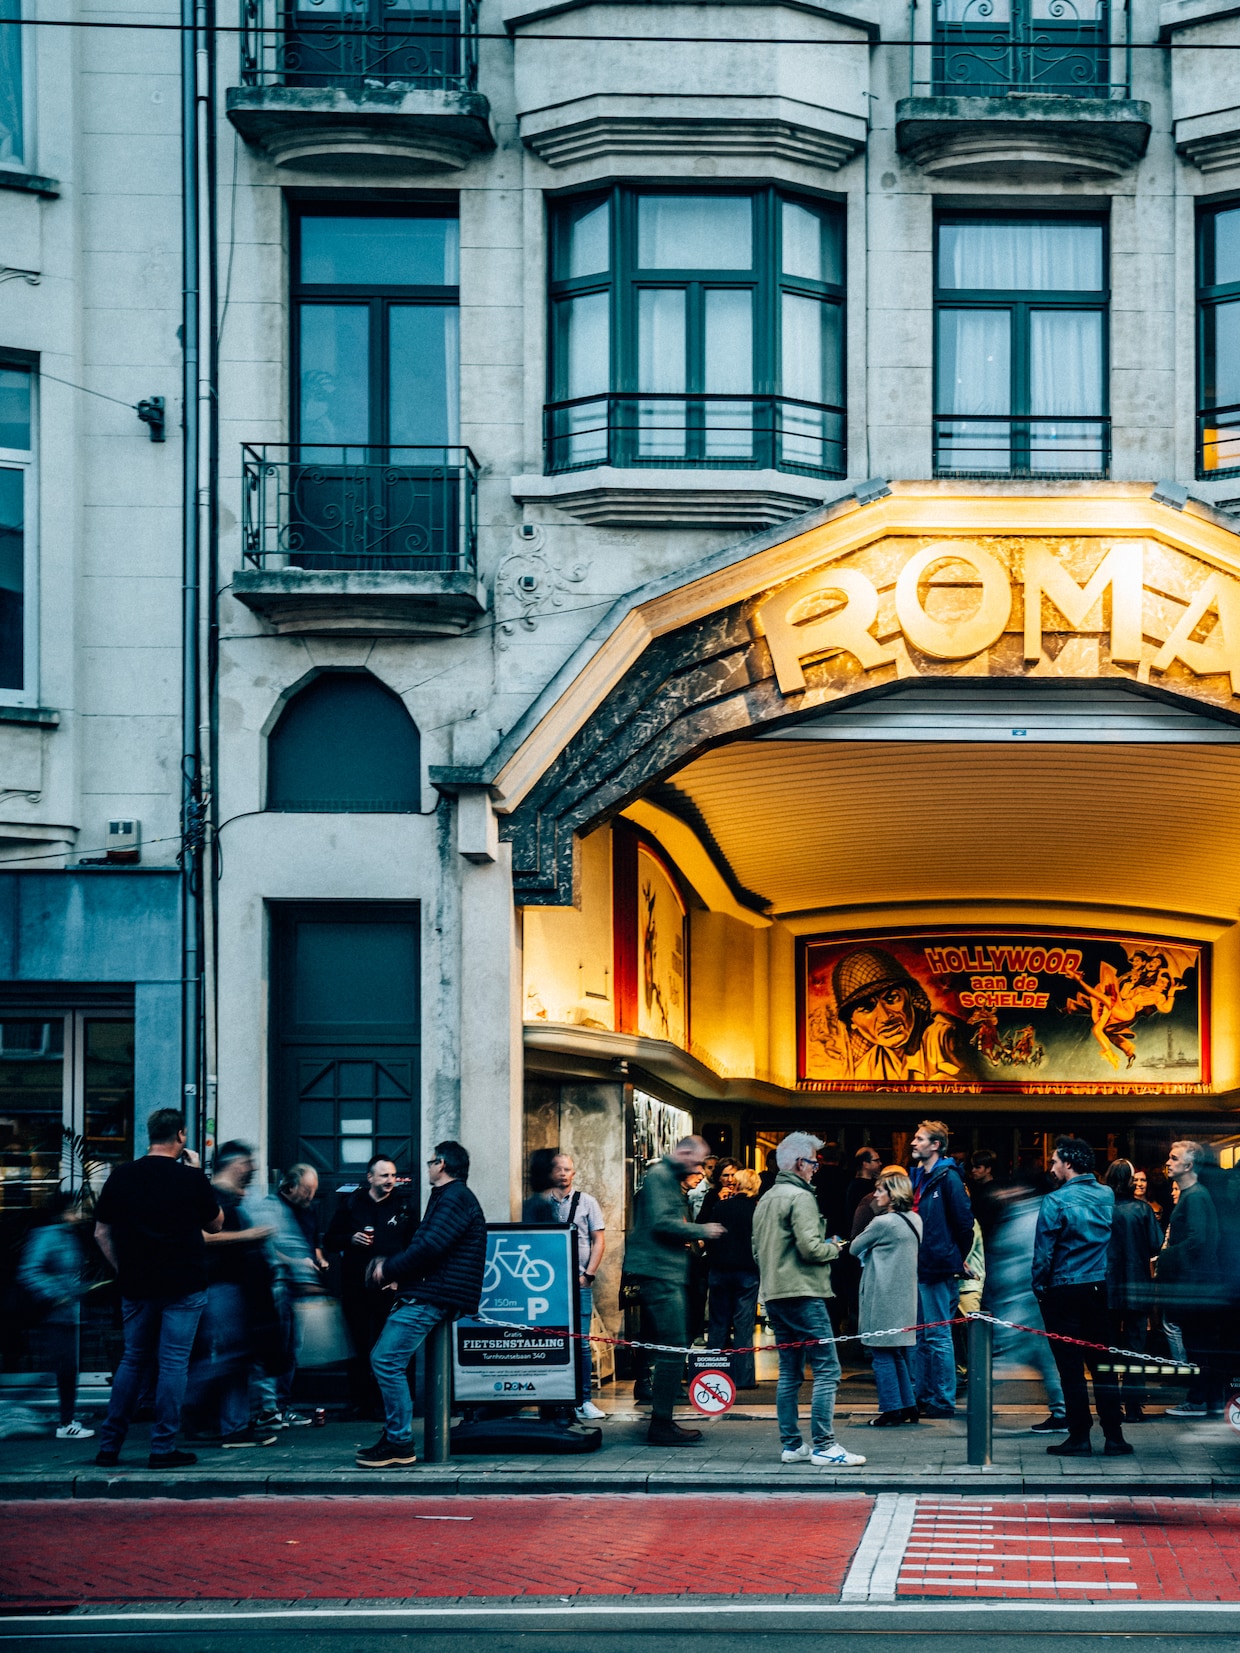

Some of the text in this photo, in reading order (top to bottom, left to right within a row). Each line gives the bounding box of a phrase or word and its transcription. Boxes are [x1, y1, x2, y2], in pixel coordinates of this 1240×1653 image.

[924, 946, 1083, 975] HOLLYWOOD
[970, 973, 1038, 991] aan de
[959, 992, 1050, 1008] SCHELDE
[494, 1297, 549, 1320] 150m P
[463, 1339, 564, 1349] FIETSENSTALLING
[504, 1382, 536, 1391] ROMA
